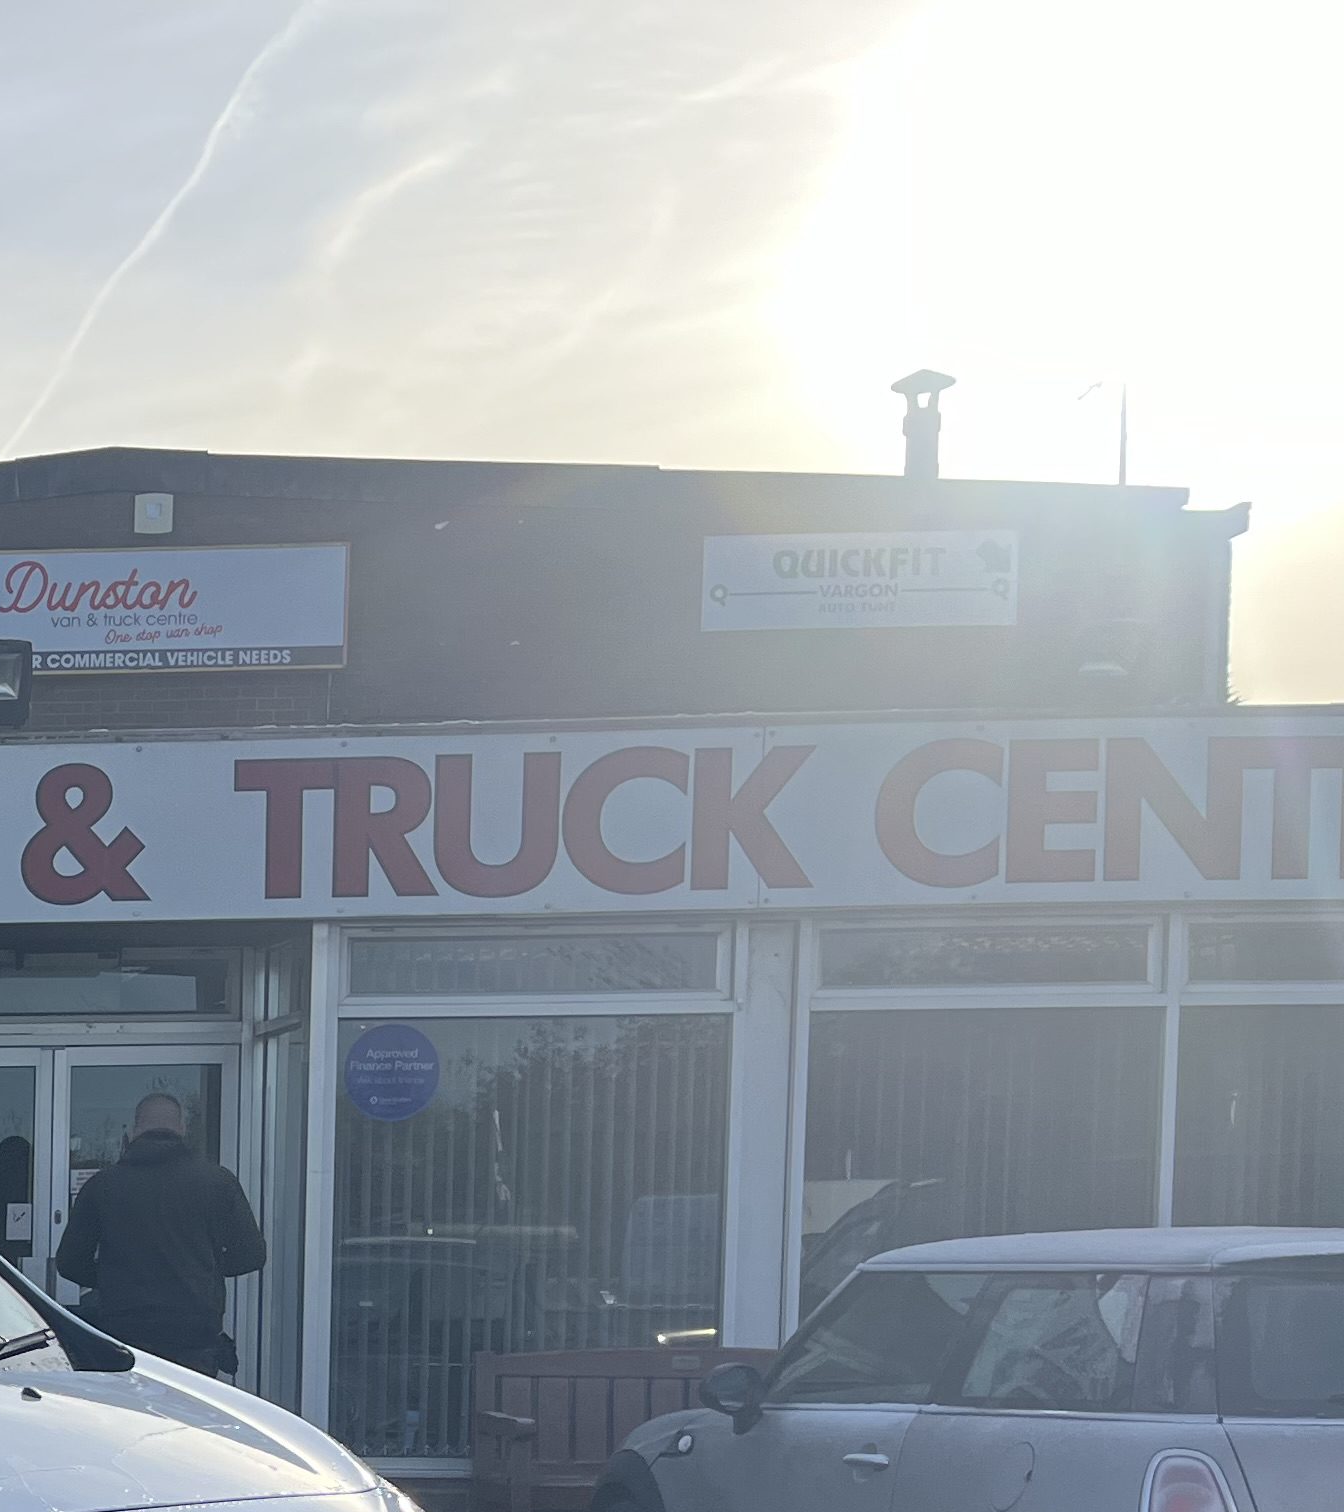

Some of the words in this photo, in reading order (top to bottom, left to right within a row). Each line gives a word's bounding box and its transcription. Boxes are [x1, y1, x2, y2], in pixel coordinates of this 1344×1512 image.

[773, 546, 947, 580] QUICKFIT
[817, 583, 900, 599] VARGON
[817, 602, 856, 614] AUTO
[51, 615, 81, 628] van
[86, 613, 98, 627] &
[103, 613, 141, 627] truck
[145, 612, 199, 626] centre
[104, 629, 132, 645] One
[136, 630, 161, 644] stop
[166, 628, 191, 640] van
[194, 622, 224, 638] shop
[46, 652, 163, 669] COMMERCIAL
[166, 650, 234, 667] VEHICLE
[238, 649, 292, 665] NEEDS
[20, 762, 153, 907] &
[233, 744, 818, 900] TRUCK
[873, 735, 1344, 889] CENT
[366, 1048, 419, 1060] Approved
[349, 1060, 393, 1072] Finance
[394, 1060, 435, 1072] Partner
